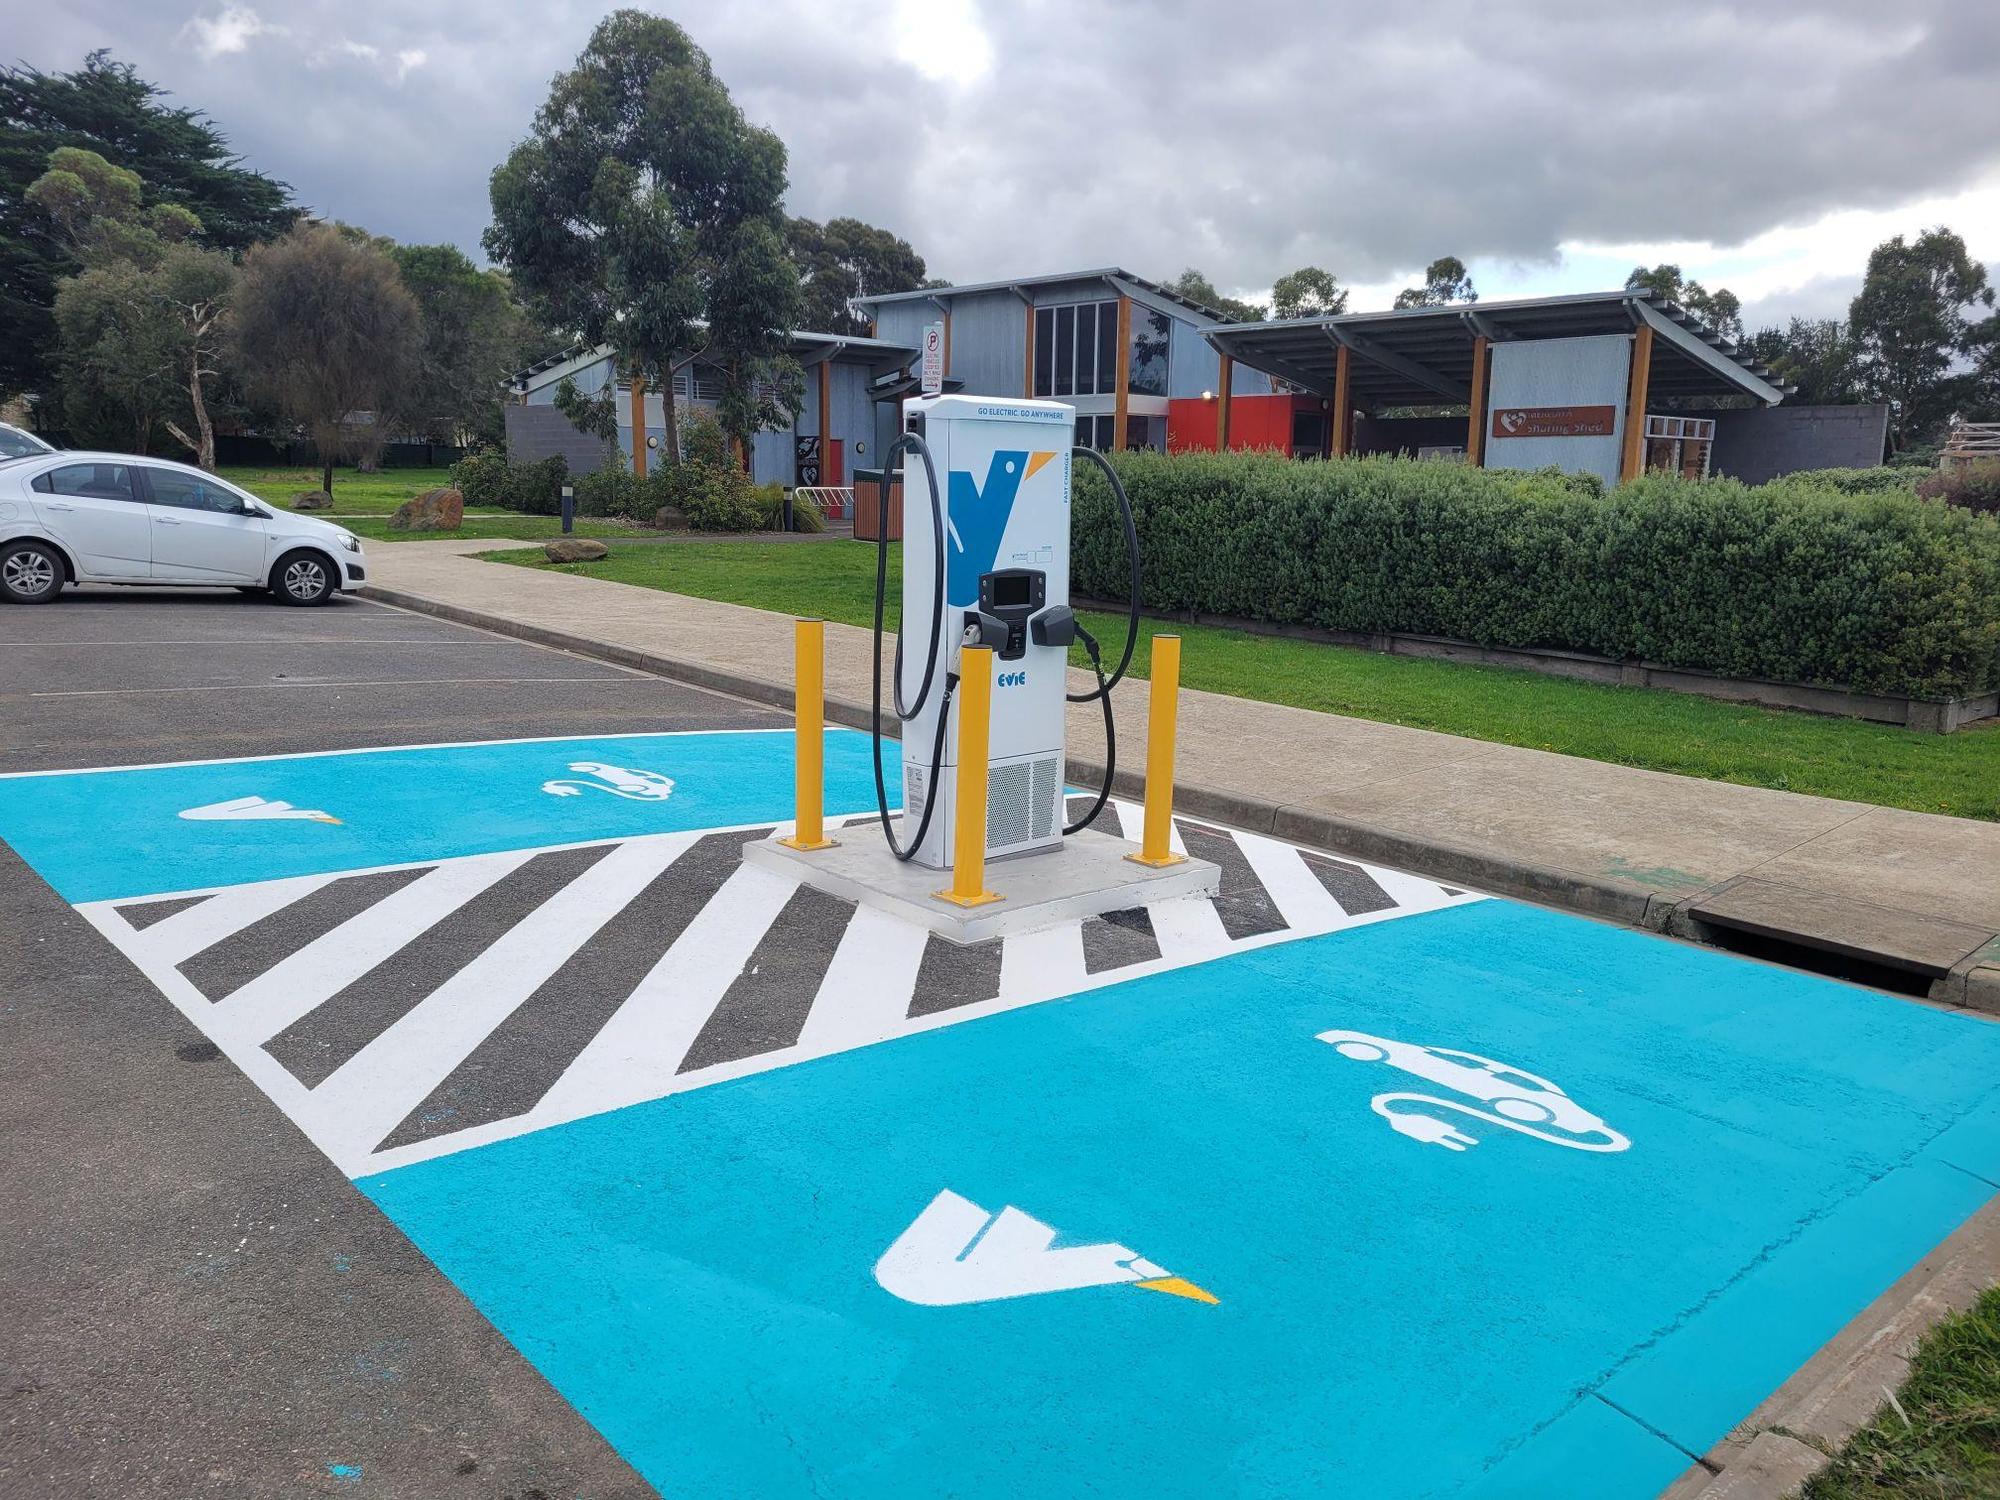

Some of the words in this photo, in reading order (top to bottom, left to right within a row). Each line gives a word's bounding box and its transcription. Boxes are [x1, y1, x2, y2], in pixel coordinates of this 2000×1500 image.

[978, 407, 988, 415] GO
[1020, 409, 1030, 417] GO
[1031, 410, 1064, 419] ANYWHERE
